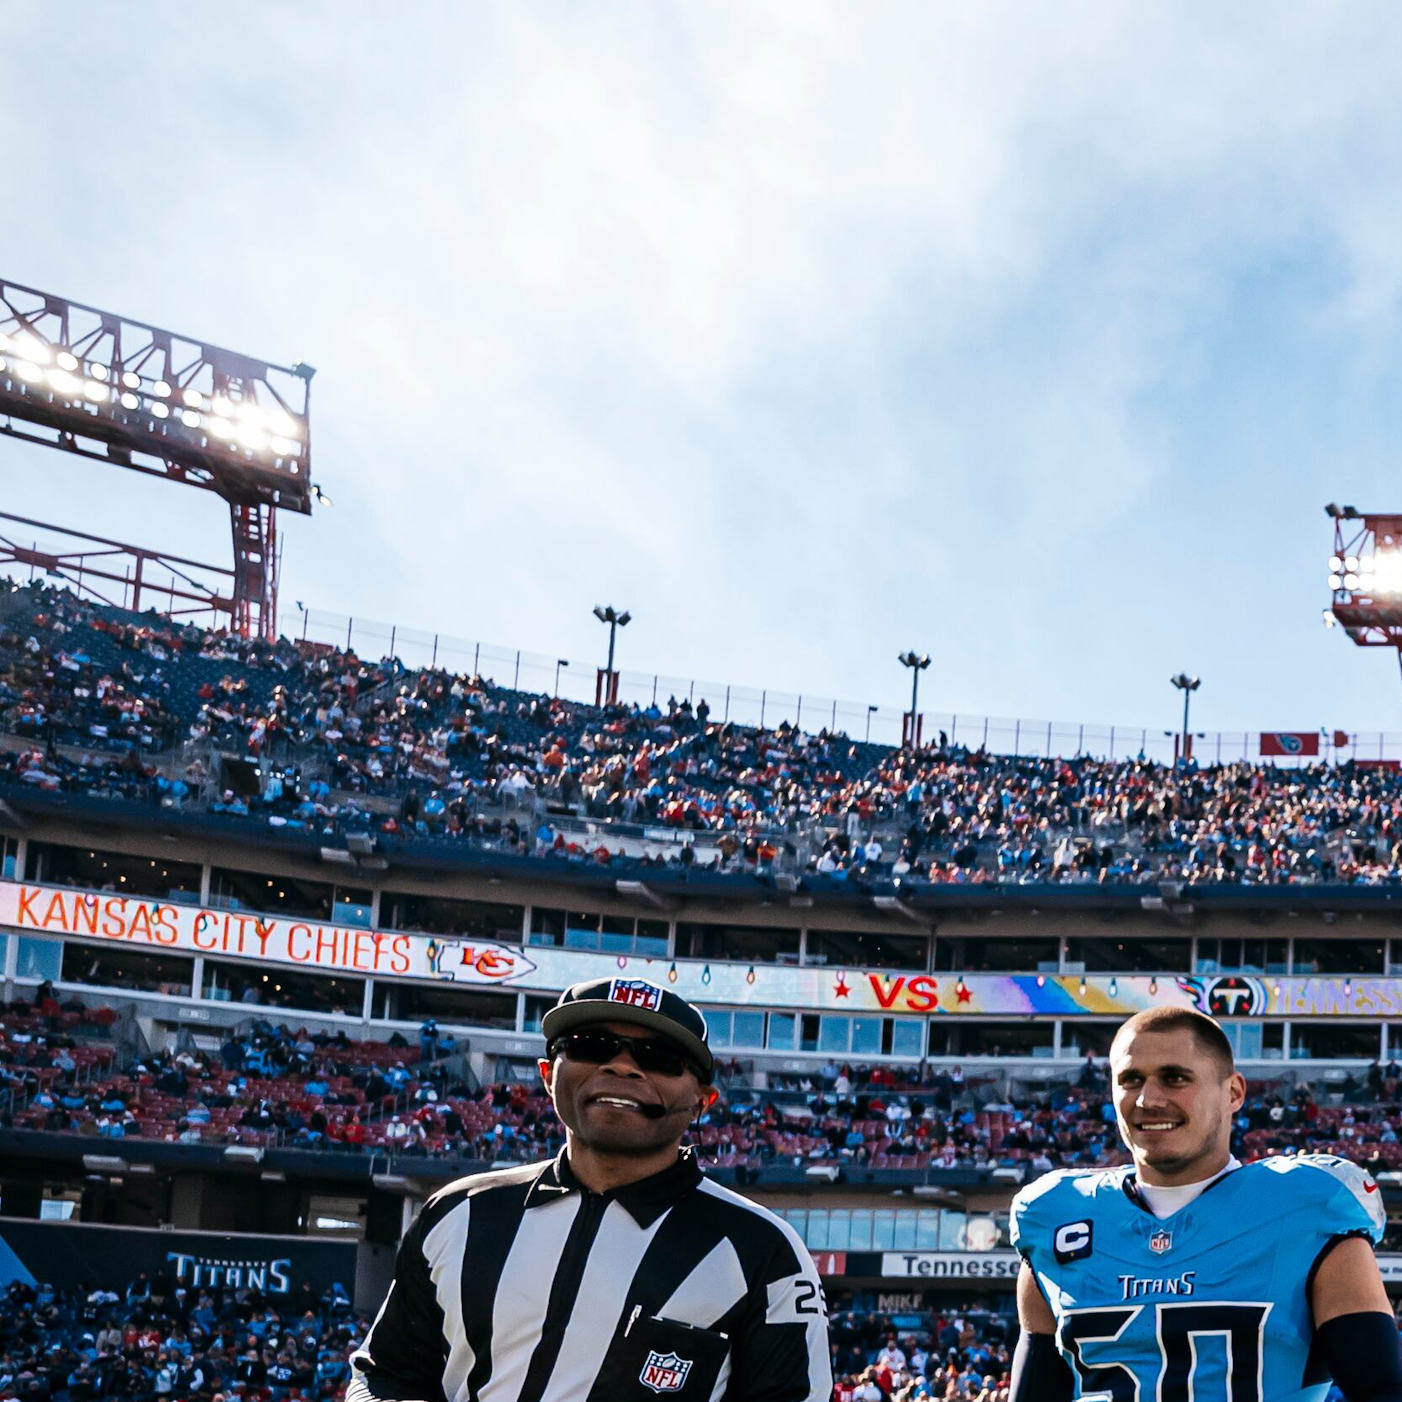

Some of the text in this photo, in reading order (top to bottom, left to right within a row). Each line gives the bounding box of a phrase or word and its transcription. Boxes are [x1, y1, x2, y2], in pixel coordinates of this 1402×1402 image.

[17, 886, 411, 973] KANSAS CITY CHIEFS
[613, 986, 656, 1010] NFL
[869, 974, 938, 1011] VS
[1055, 1222, 1090, 1253] C
[649, 1366, 679, 1389] NFL
